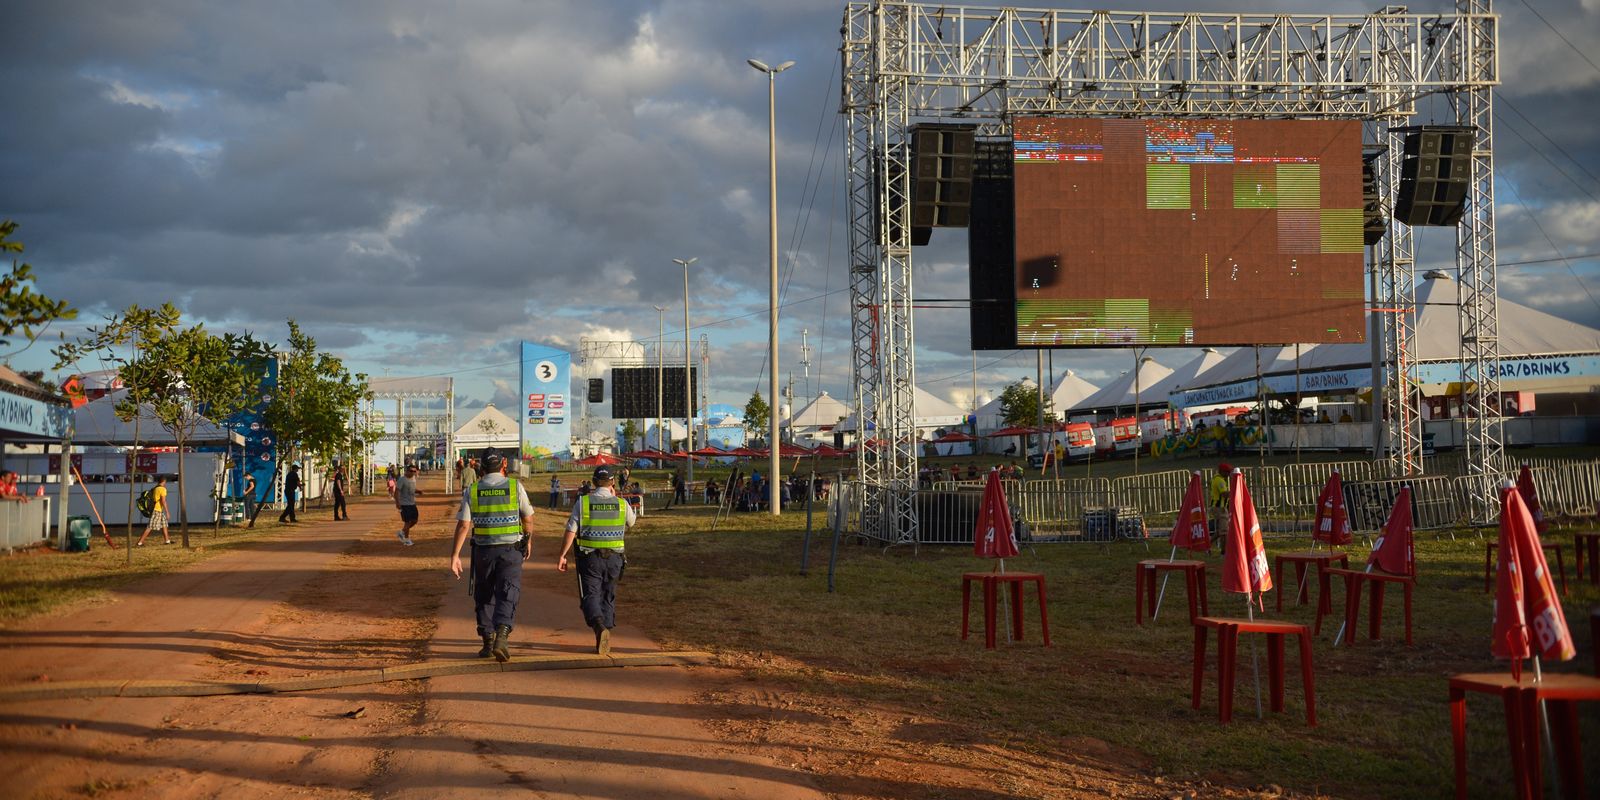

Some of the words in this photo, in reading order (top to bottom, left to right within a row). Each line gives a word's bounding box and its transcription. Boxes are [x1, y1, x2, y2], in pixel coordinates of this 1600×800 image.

[541, 364, 552, 379] 3
[1489, 361, 1570, 379] BAR/DRINKS
[1305, 373, 1349, 388] BAR/DRINKS
[0, 398, 33, 426] R/DRINKS
[480, 488, 506, 497] POLÍCIA
